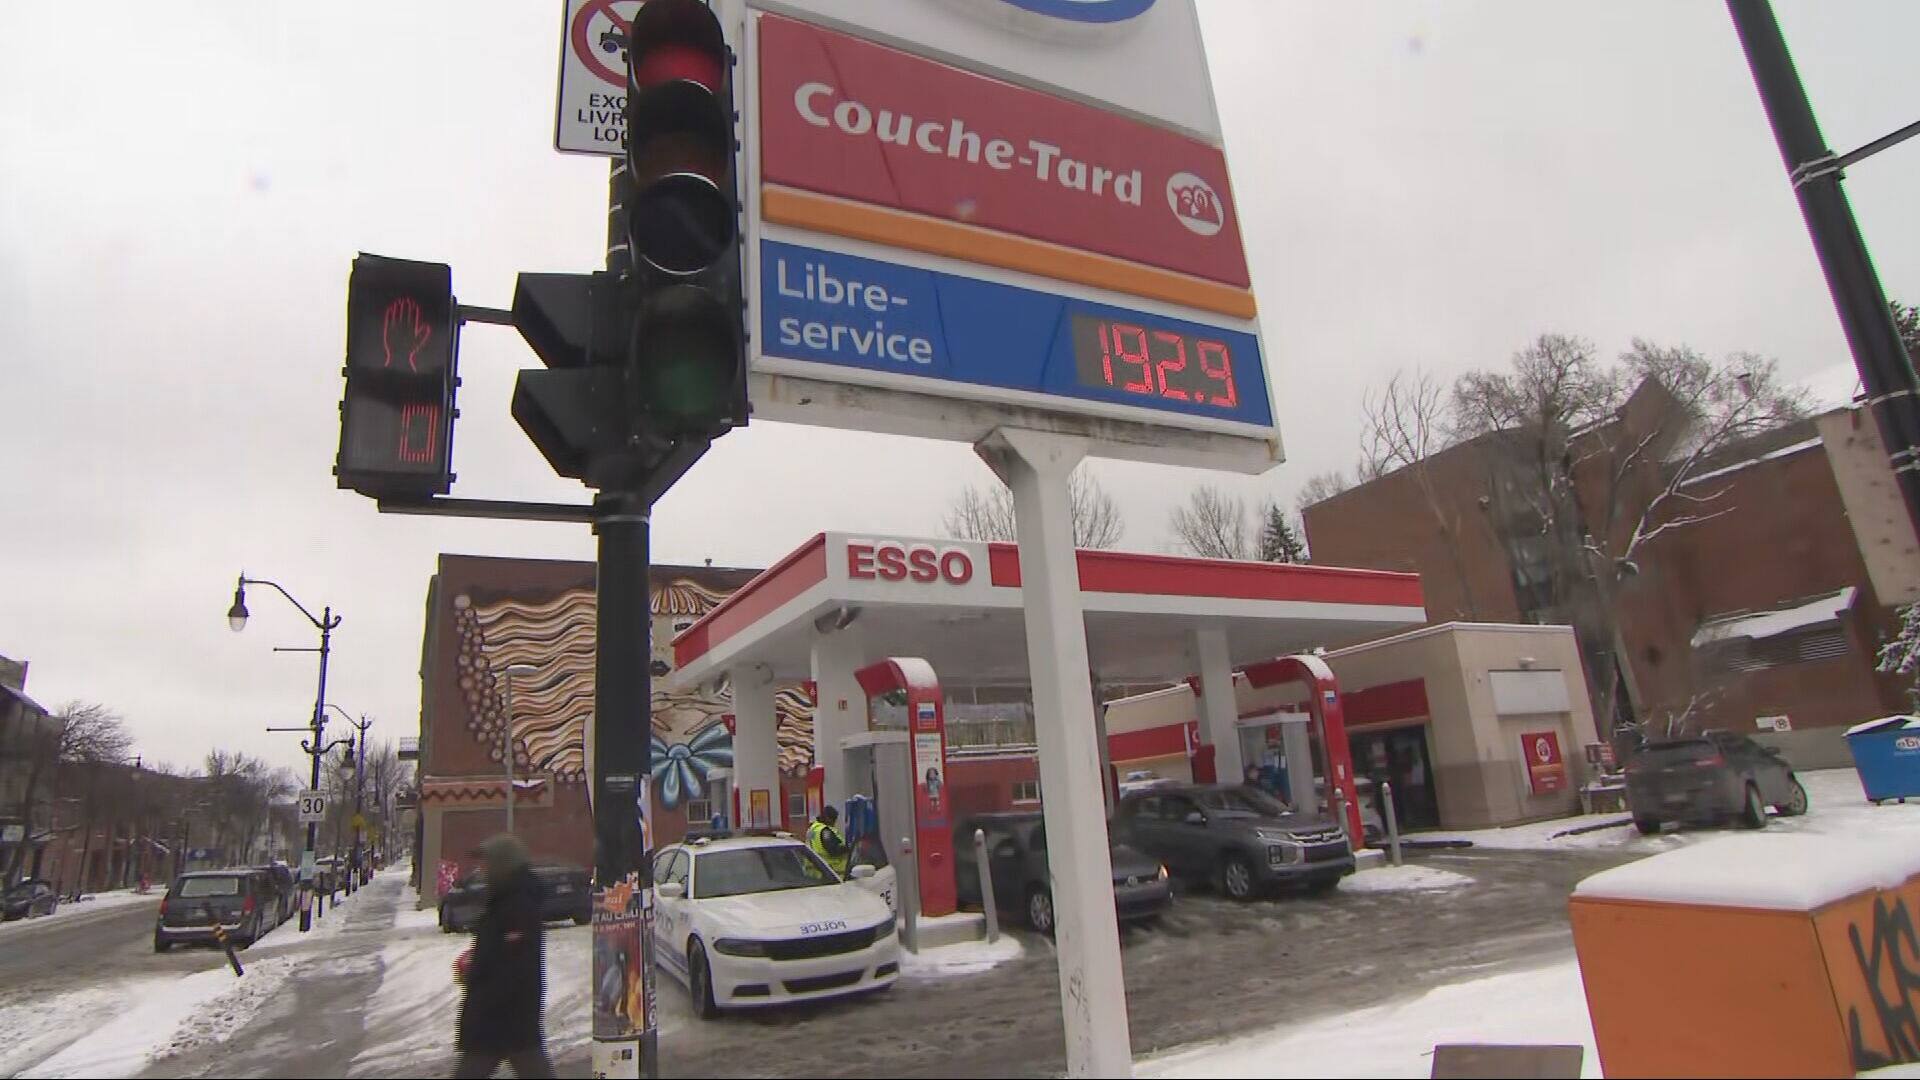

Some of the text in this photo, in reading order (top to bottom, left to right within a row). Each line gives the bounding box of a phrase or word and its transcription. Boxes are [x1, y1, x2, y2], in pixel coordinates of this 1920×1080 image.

[794, 82, 1143, 207] Couche-Tard
[777, 258, 908, 311] Libre-
[778, 316, 933, 364] service
[1099, 323, 1238, 408] 192.9
[847, 544, 973, 585] ESSO
[302, 798, 324, 813] 30
